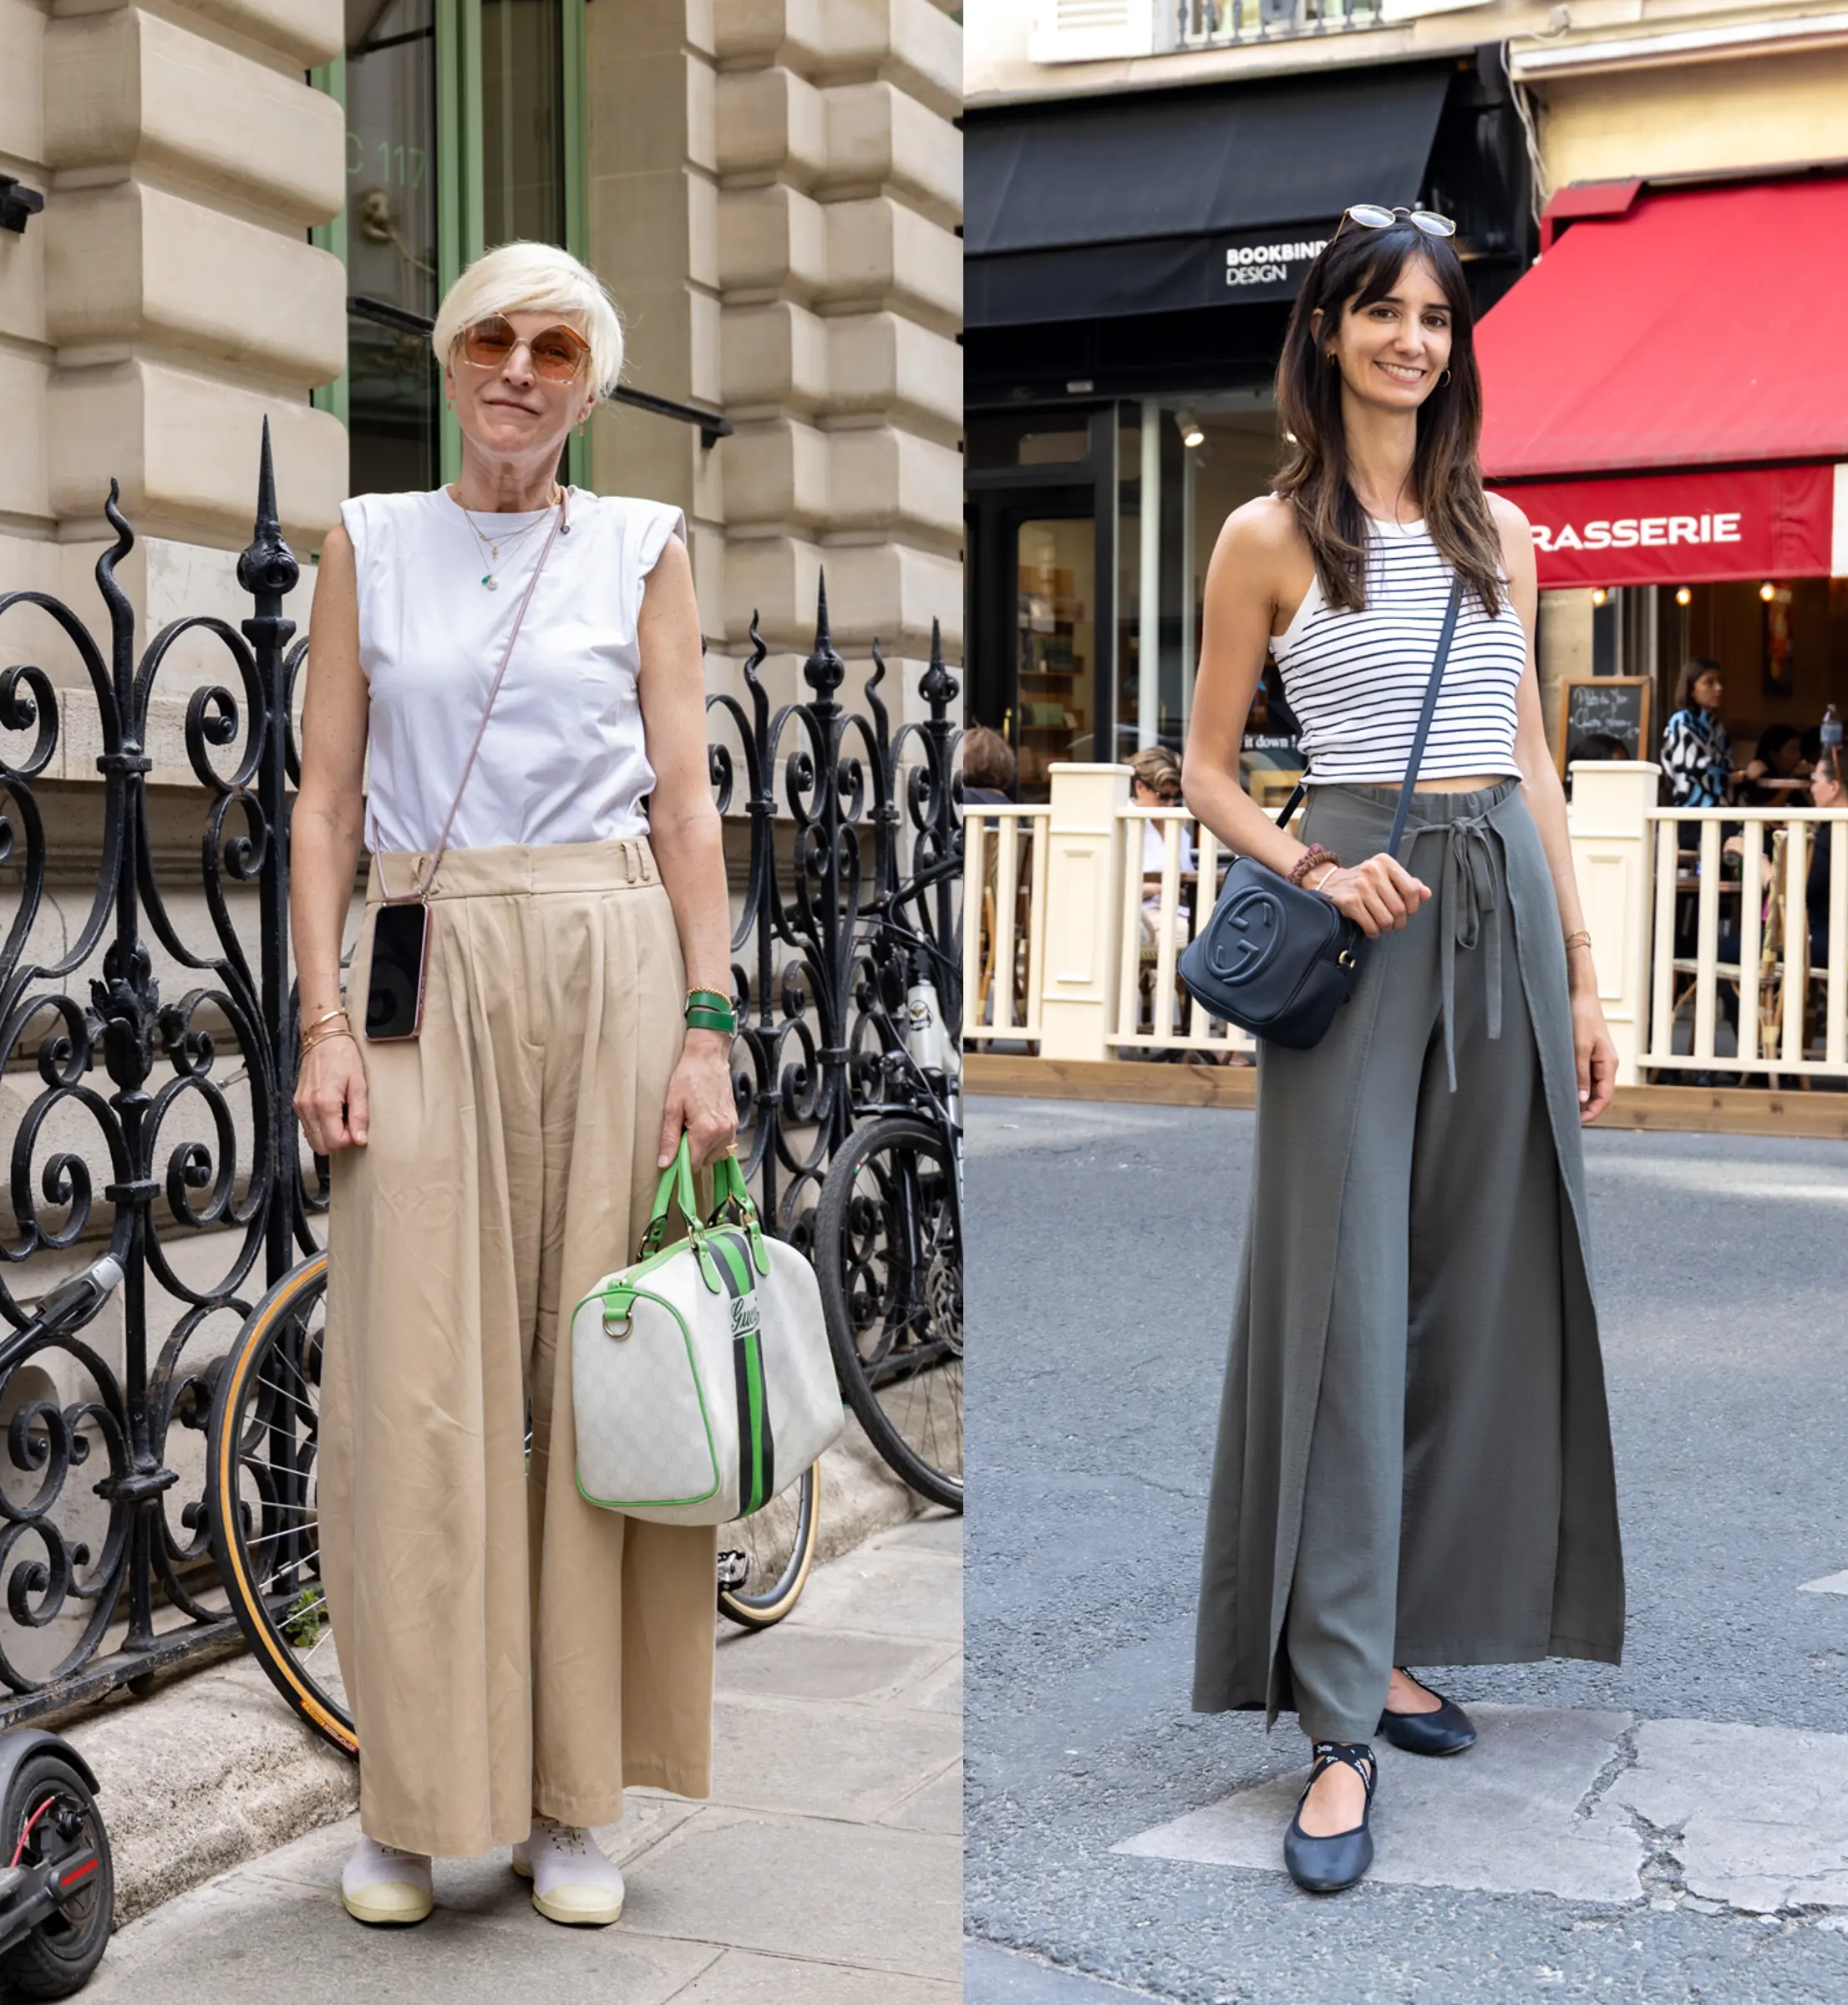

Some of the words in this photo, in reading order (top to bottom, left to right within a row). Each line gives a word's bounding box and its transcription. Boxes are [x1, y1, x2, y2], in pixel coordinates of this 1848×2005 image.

[378, 141, 427, 190] 117
[1226, 264, 1287, 286] DESIGN
[1256, 734, 1288, 749] down
